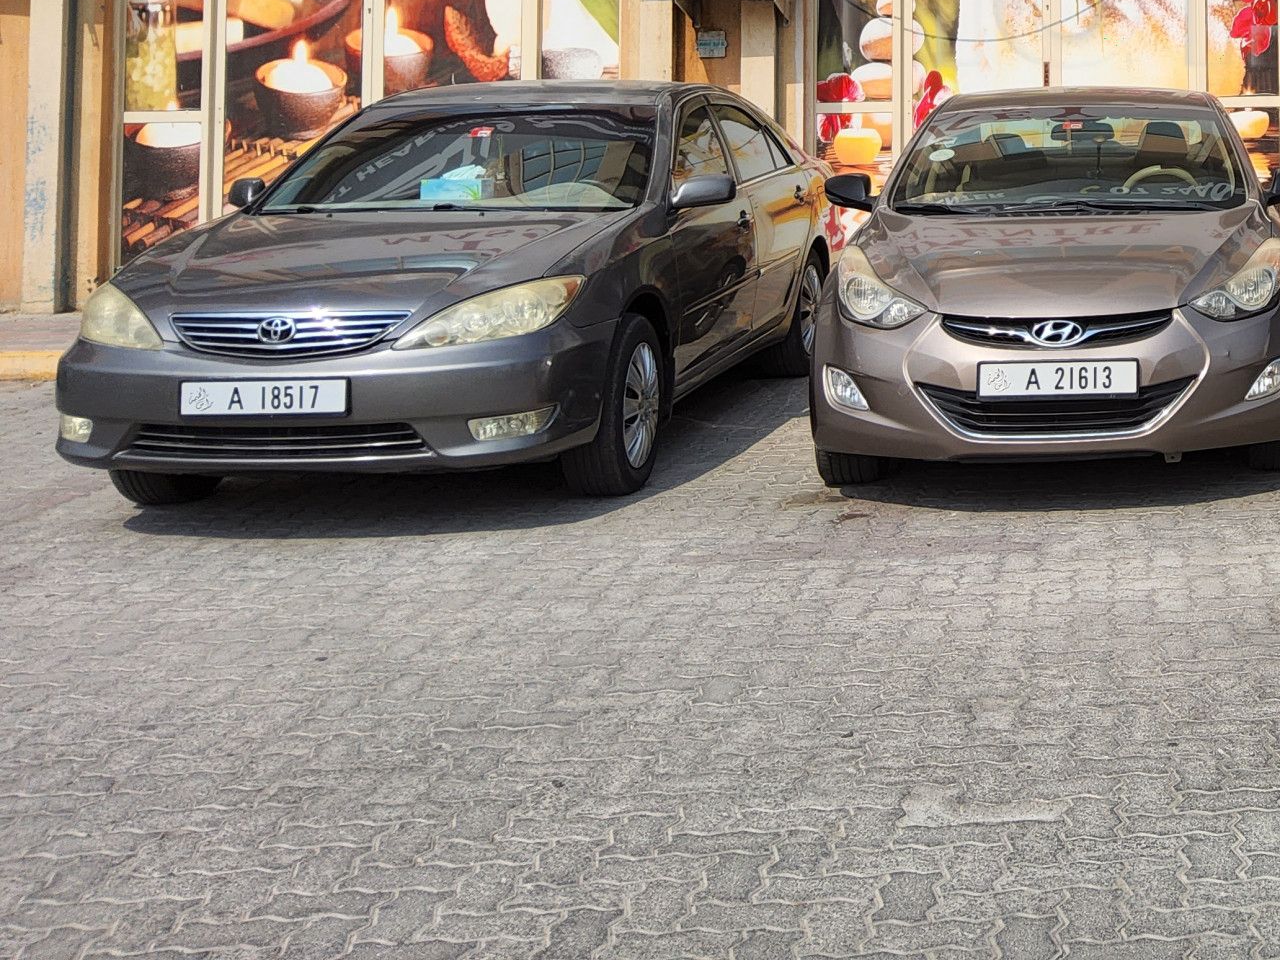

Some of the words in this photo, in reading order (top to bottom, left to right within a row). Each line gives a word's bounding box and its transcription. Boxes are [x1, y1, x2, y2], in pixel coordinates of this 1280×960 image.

[1025, 368, 1041, 390] A
[1054, 366, 1112, 390] 21613
[227, 387, 244, 410] A
[261, 385, 319, 410] 18517
